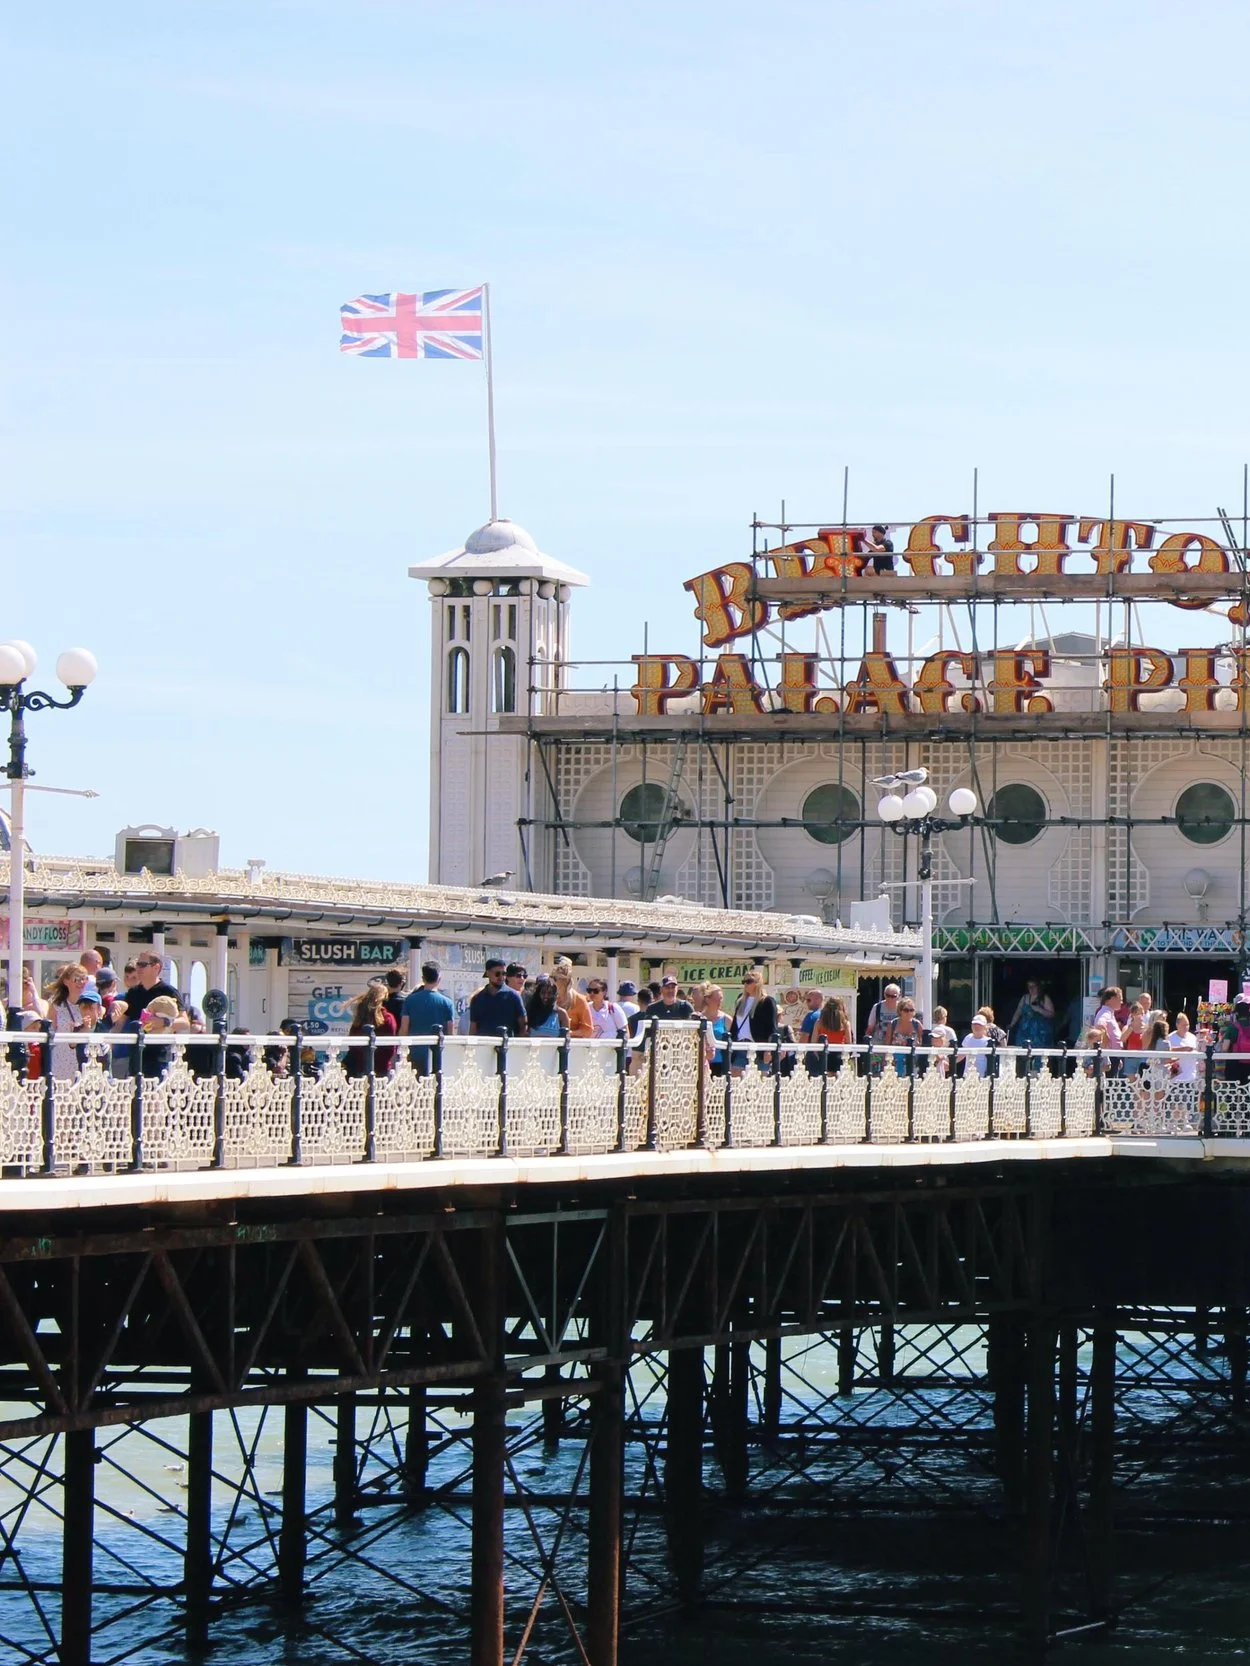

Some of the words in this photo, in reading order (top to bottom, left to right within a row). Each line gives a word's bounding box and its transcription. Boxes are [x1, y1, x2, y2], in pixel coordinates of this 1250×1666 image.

[631, 650, 1054, 713] PALACE
[45, 926, 67, 941] FLOSS
[301, 944, 355, 959] SLUSH
[361, 945, 394, 960] BAR
[464, 950, 486, 964] SLUSH
[684, 968, 706, 981] ICE
[312, 986, 343, 999] GET
